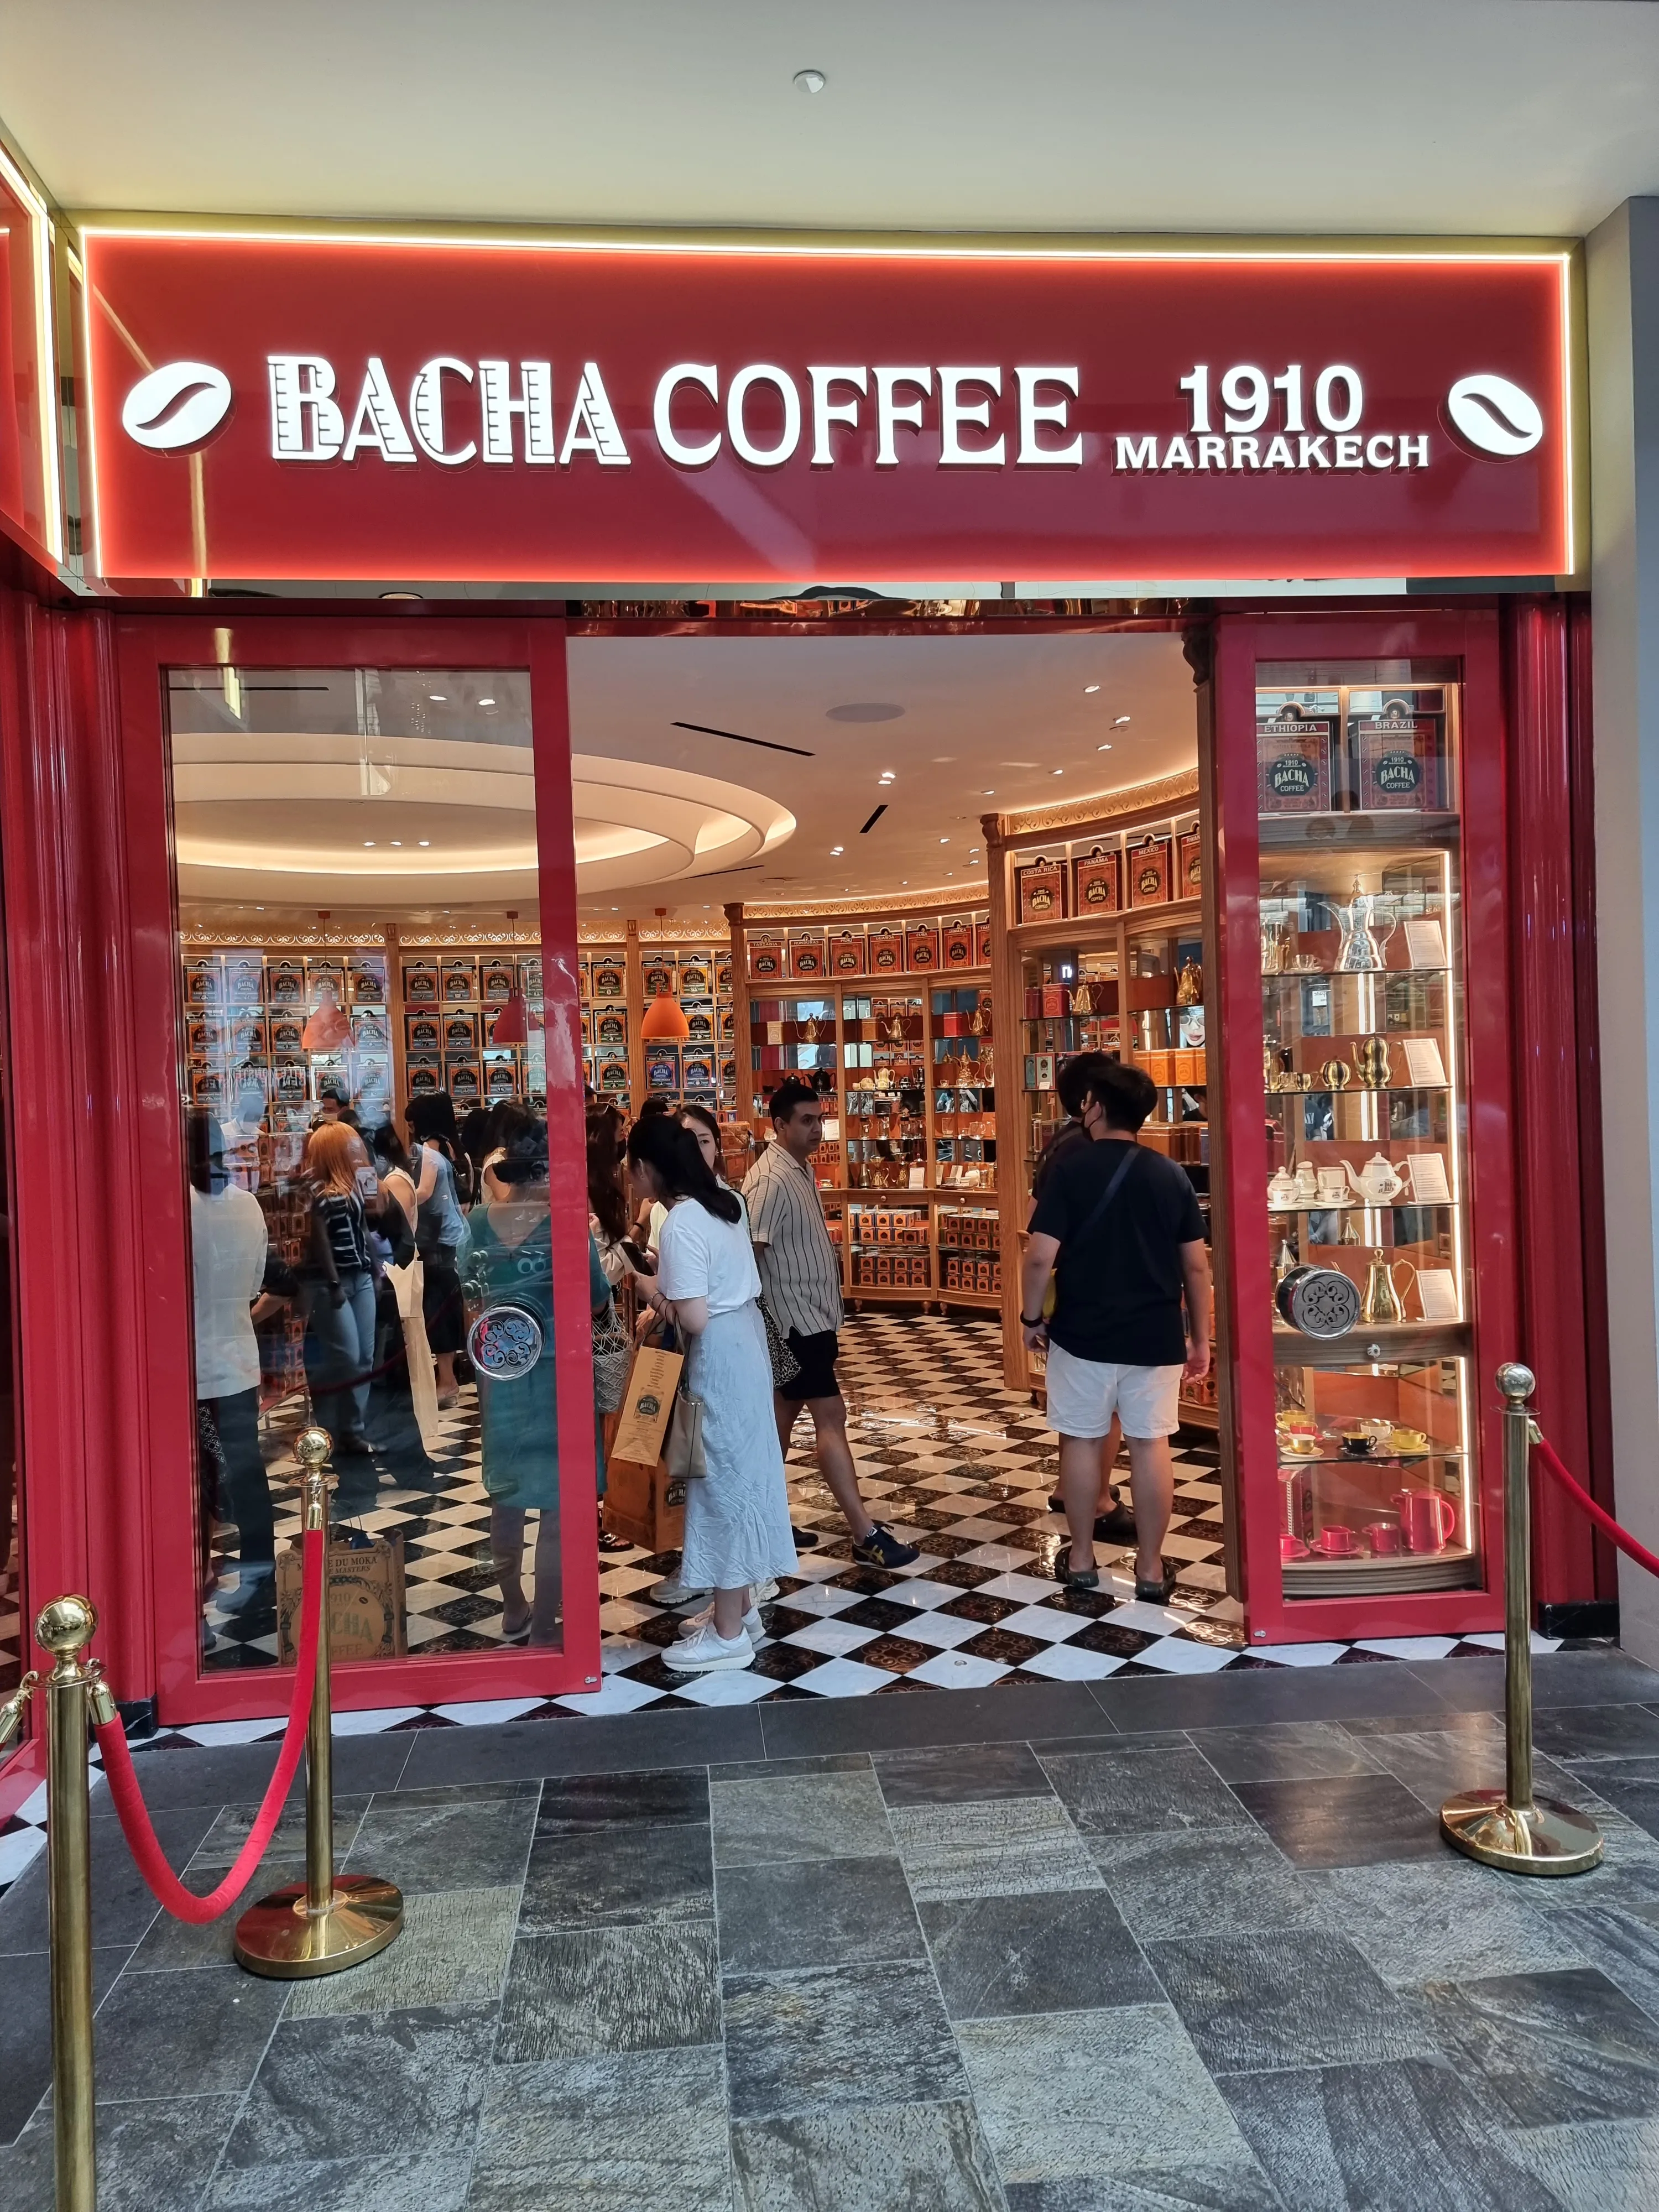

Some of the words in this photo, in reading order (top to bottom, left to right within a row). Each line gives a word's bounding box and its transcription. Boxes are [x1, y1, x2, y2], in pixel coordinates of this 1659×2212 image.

[1180, 365, 1363, 433] 1910
[267, 354, 632, 465] BACHA
[653, 363, 1083, 466] COFFEE
[1115, 435, 1430, 470] MARRAKECH
[1264, 724, 1317, 733] ETHIOPIA
[1375, 721, 1418, 729] BRAZIL
[1275, 769, 1310, 788] BACHA
[1381, 766, 1415, 785] BACHA
[1186, 834, 1201, 843] RWAN
[1139, 846, 1159, 855] MEXICO
[1084, 857, 1108, 865] PANAMA
[1191, 866, 1201, 879] BAC
[1141, 877, 1157, 890] BACHA
[1088, 886, 1106, 899] BACHA
[1032, 895, 1050, 907] BACHA
[916, 951, 929, 959] BACHA
[952, 948, 964, 957] BACHA
[361, 980, 376, 989] BACHA
[363, 1029, 378, 1037] BACHA
[336, 1558, 348, 1567] DU
[351, 1556, 377, 1566] MOKA
[335, 1566, 370, 1574] MASTERS
[330, 1593, 350, 1603] 910
[331, 1611, 373, 1644] CHA
